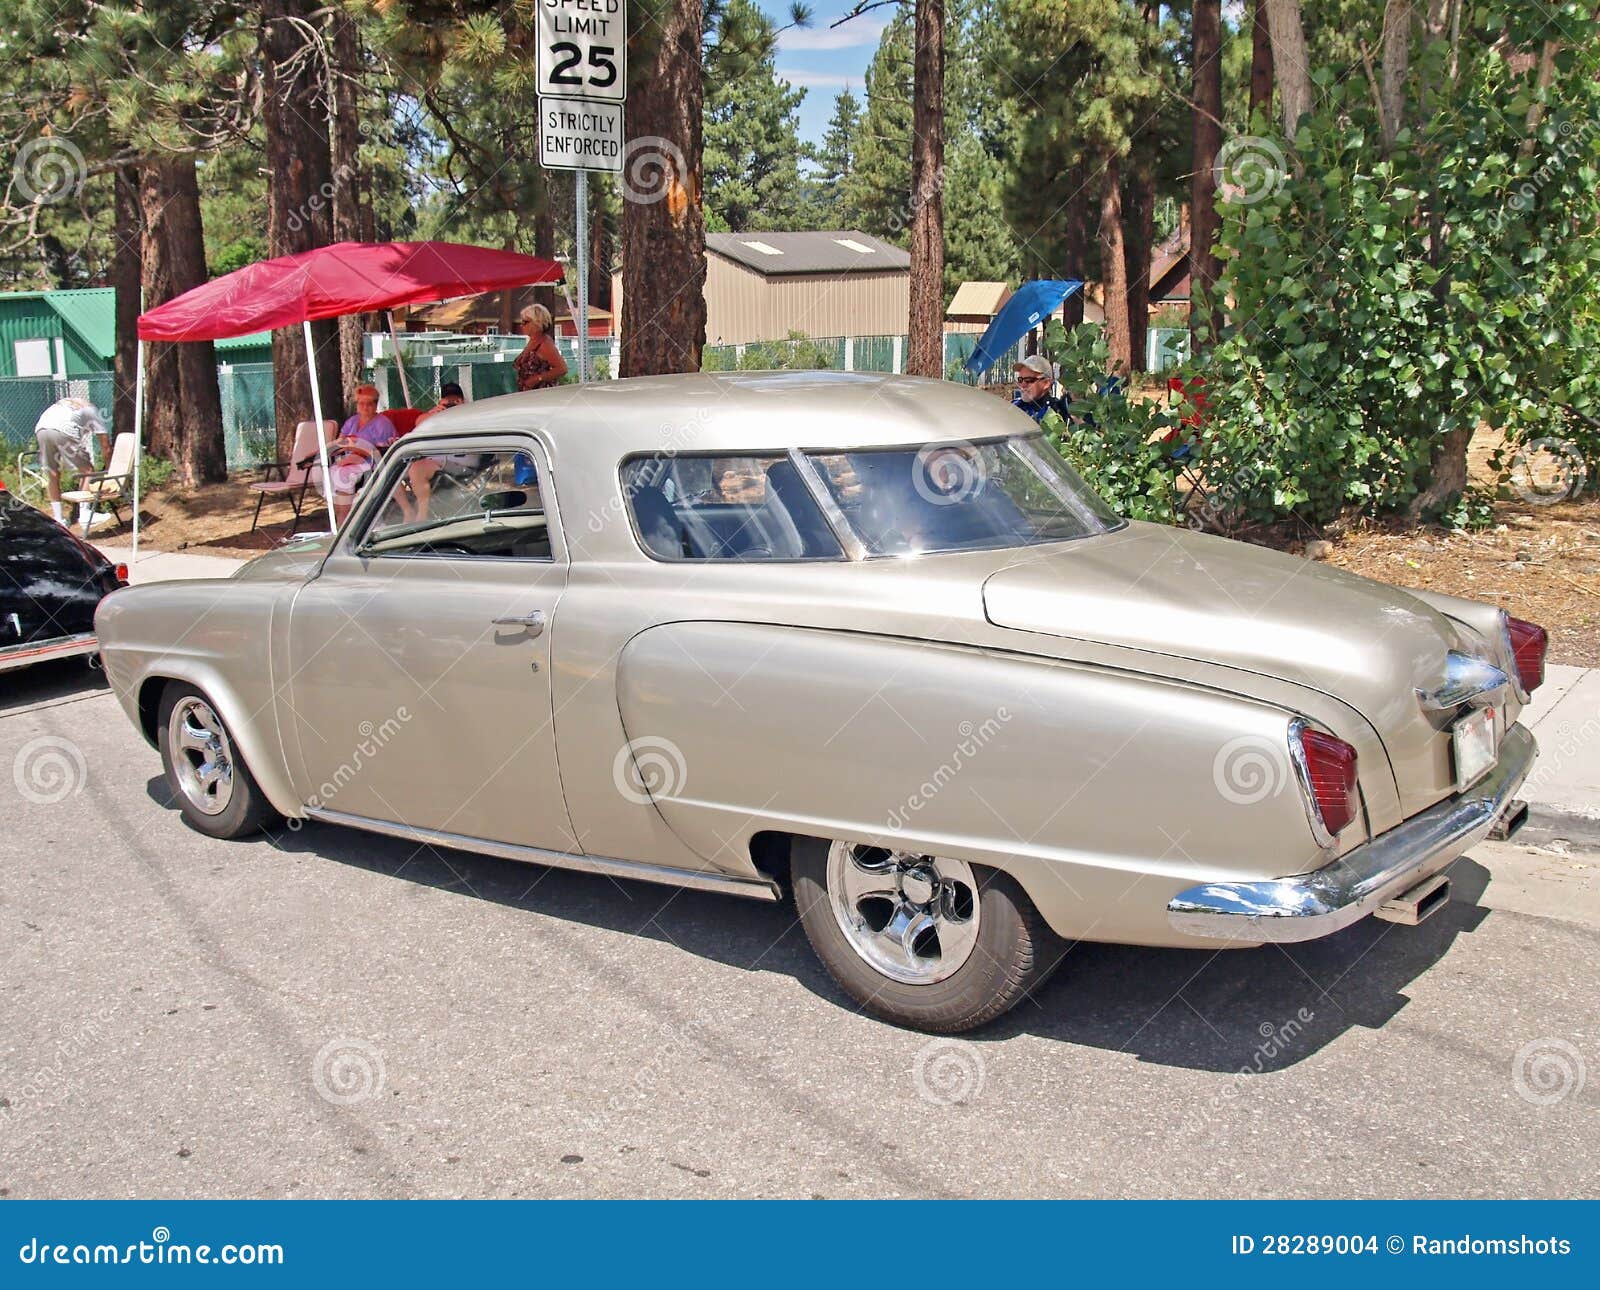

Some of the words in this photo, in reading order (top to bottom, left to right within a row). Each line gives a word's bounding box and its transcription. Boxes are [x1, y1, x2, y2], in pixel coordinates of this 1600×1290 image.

[554, 15, 610, 37] LIMIT
[549, 41, 617, 88] 25
[548, 111, 615, 134] STRICTLY
[546, 135, 619, 157] ENFORCED
